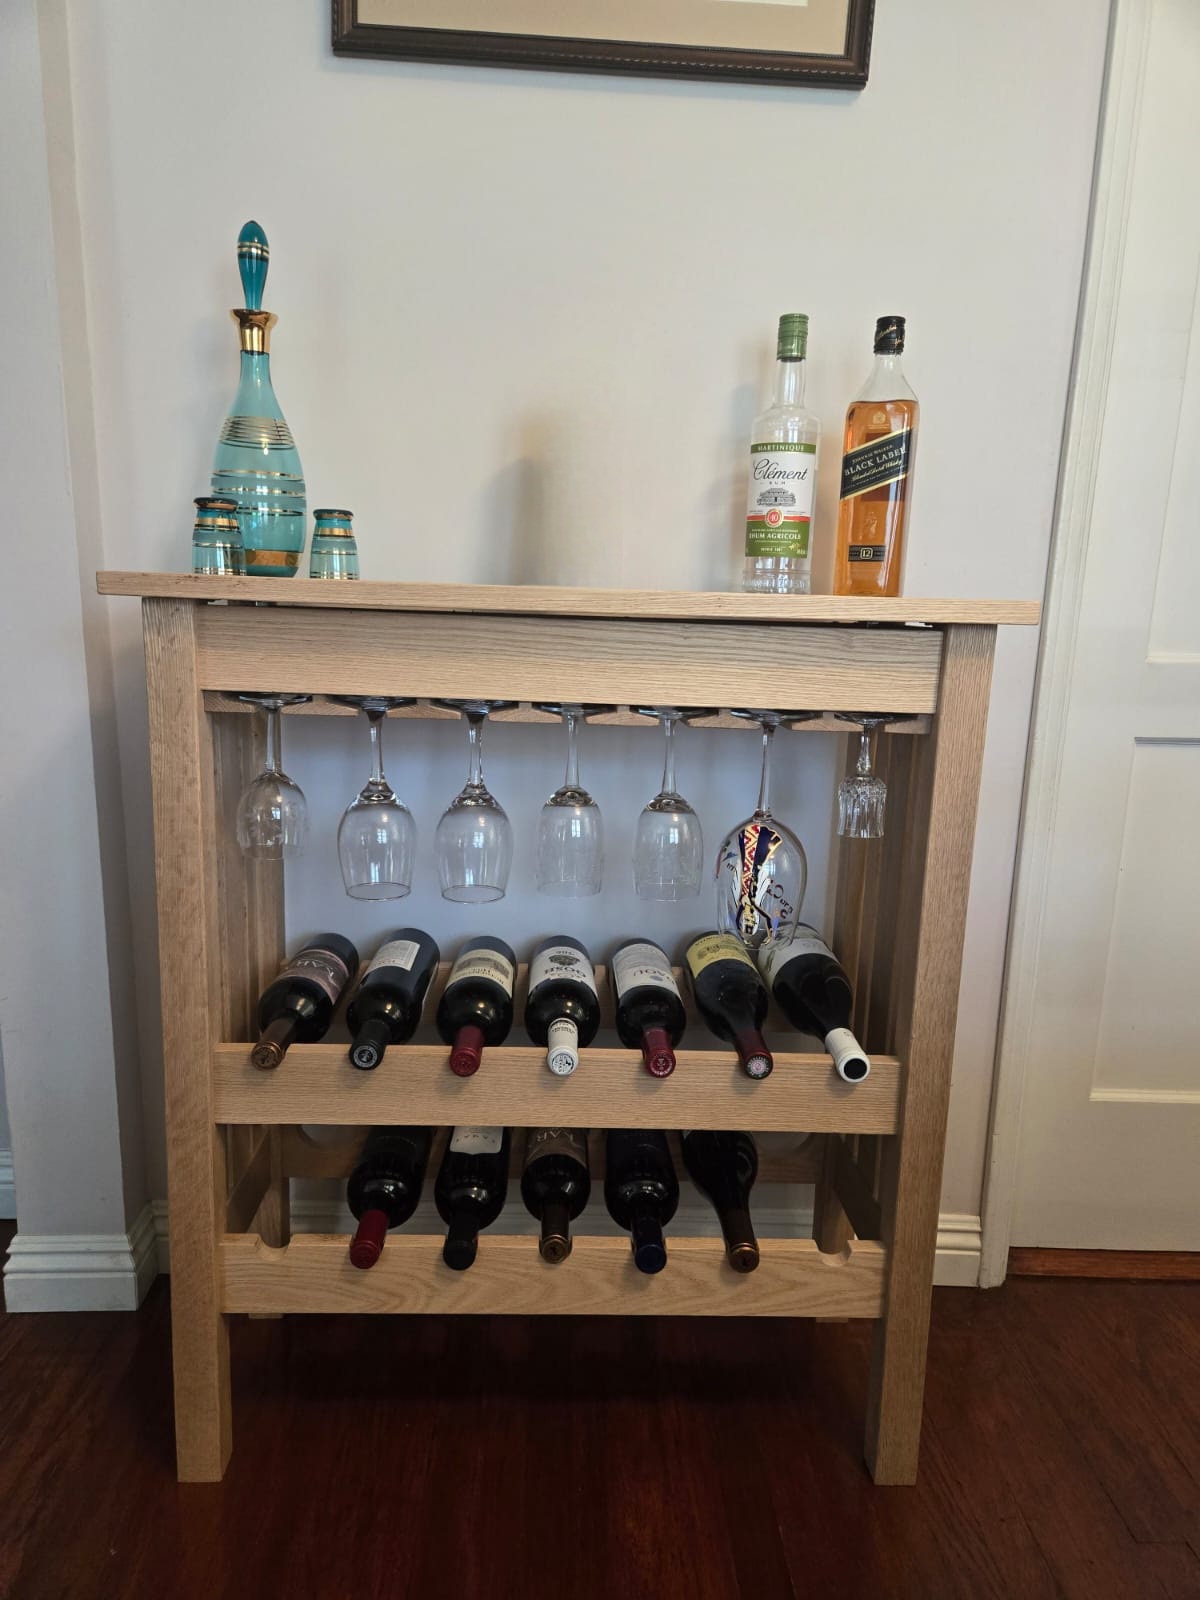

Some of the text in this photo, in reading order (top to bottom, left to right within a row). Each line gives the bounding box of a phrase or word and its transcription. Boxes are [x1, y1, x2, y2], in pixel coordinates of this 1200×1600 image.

[757, 444, 804, 452] MARTINIQUE
[752, 458, 809, 481] Clément
[844, 447, 906, 476] BLACK LABEL
